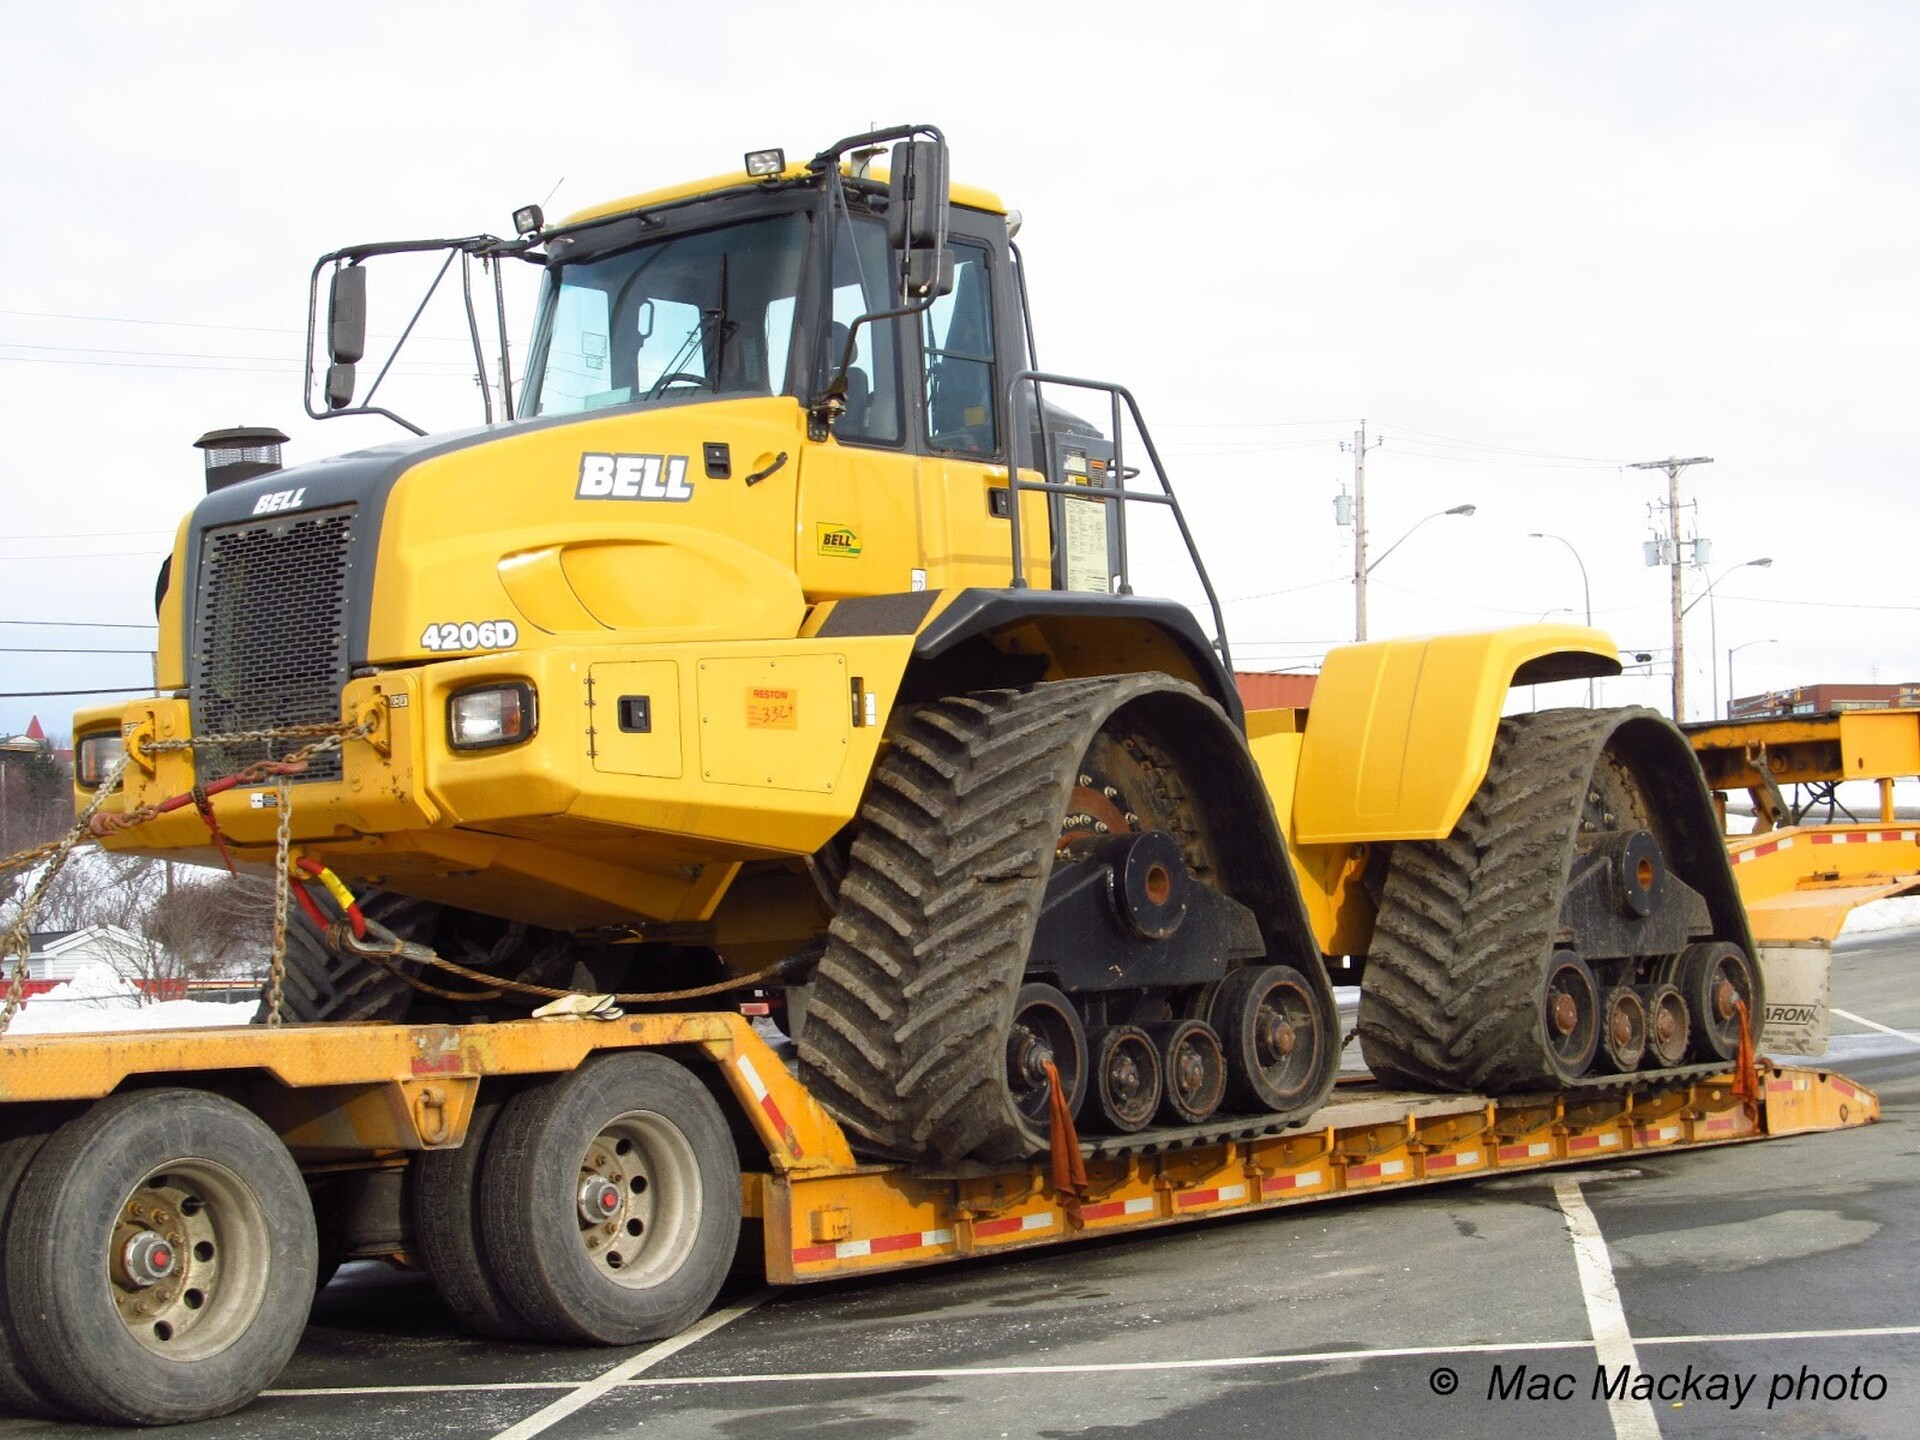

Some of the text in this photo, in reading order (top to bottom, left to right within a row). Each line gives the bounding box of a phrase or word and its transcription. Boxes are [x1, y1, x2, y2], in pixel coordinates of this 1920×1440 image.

[577, 453, 693, 501] BELL
[252, 487, 306, 515] BELL
[823, 533, 852, 547] BELL
[420, 620, 518, 651] 4206D
[753, 689, 788, 700] RESTOW
